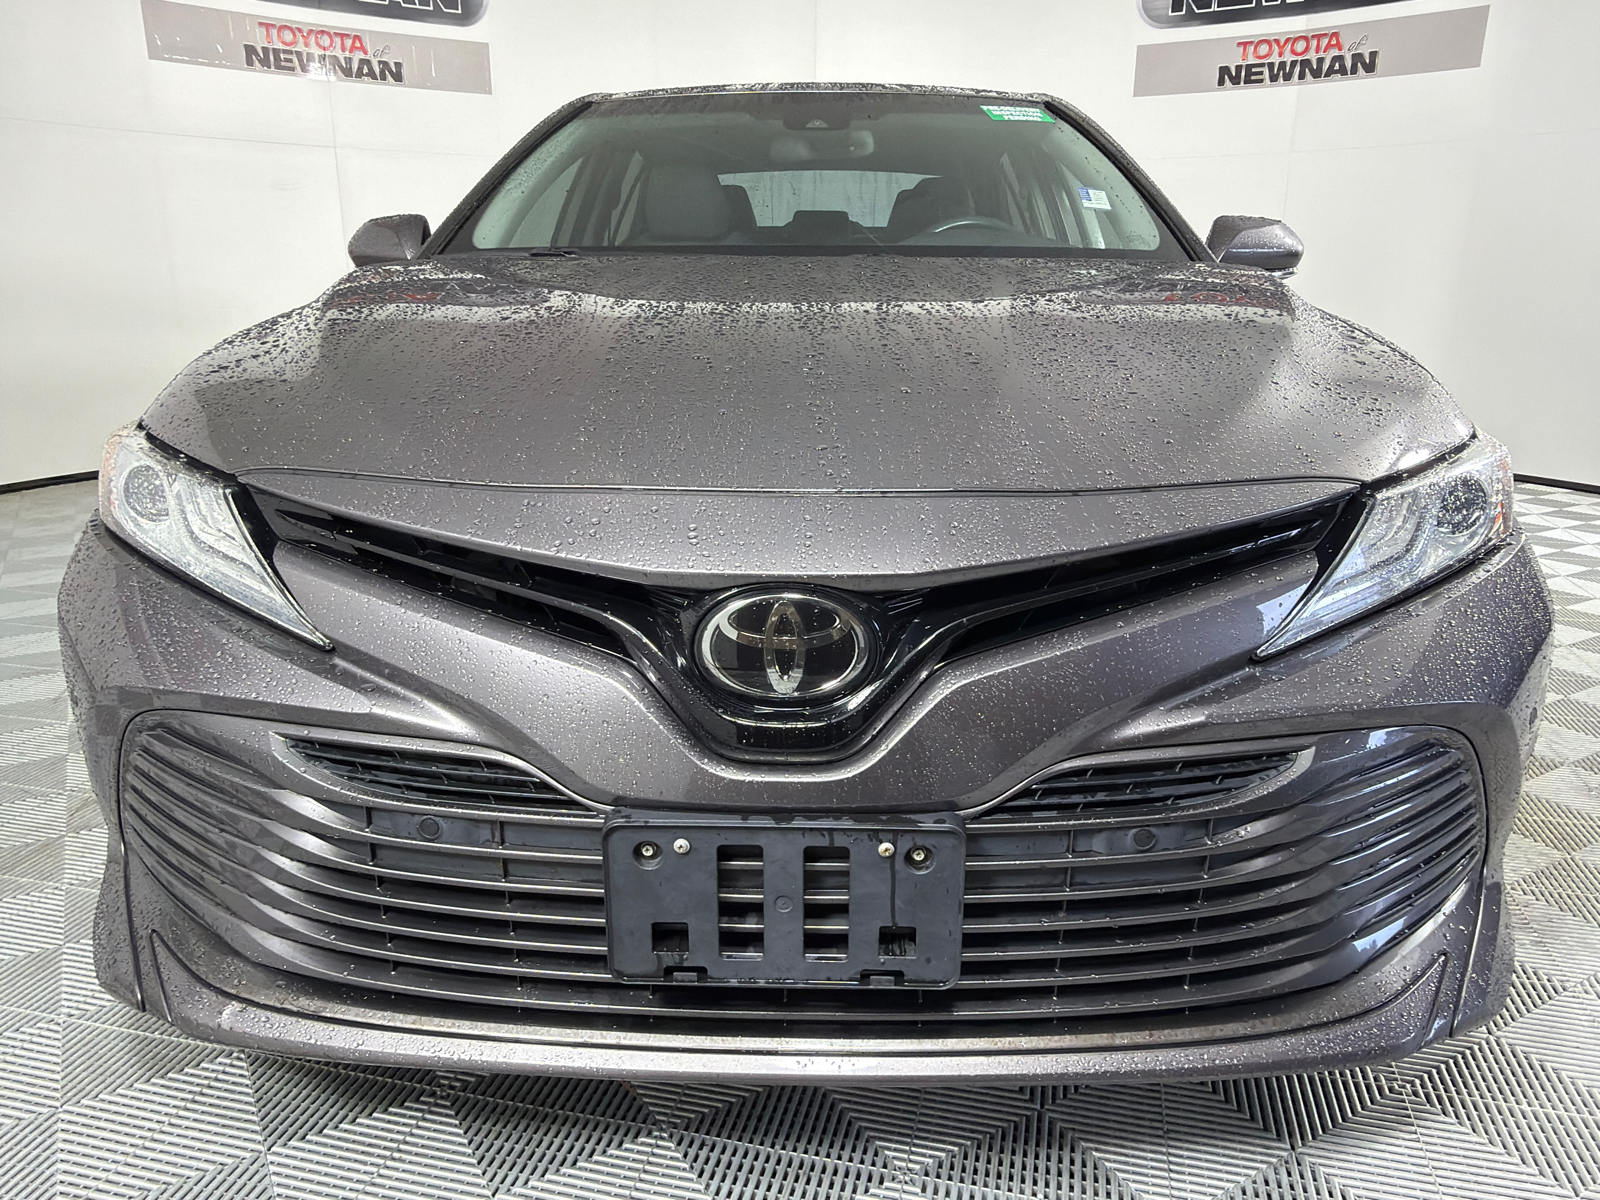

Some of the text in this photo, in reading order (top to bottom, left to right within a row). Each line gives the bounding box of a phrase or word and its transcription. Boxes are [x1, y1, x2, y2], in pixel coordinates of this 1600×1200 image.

[258, 21, 391, 59] TOYOTA of
[1237, 31, 1369, 62] TOYOTA of
[1217, 50, 1378, 88] NEWNAN
